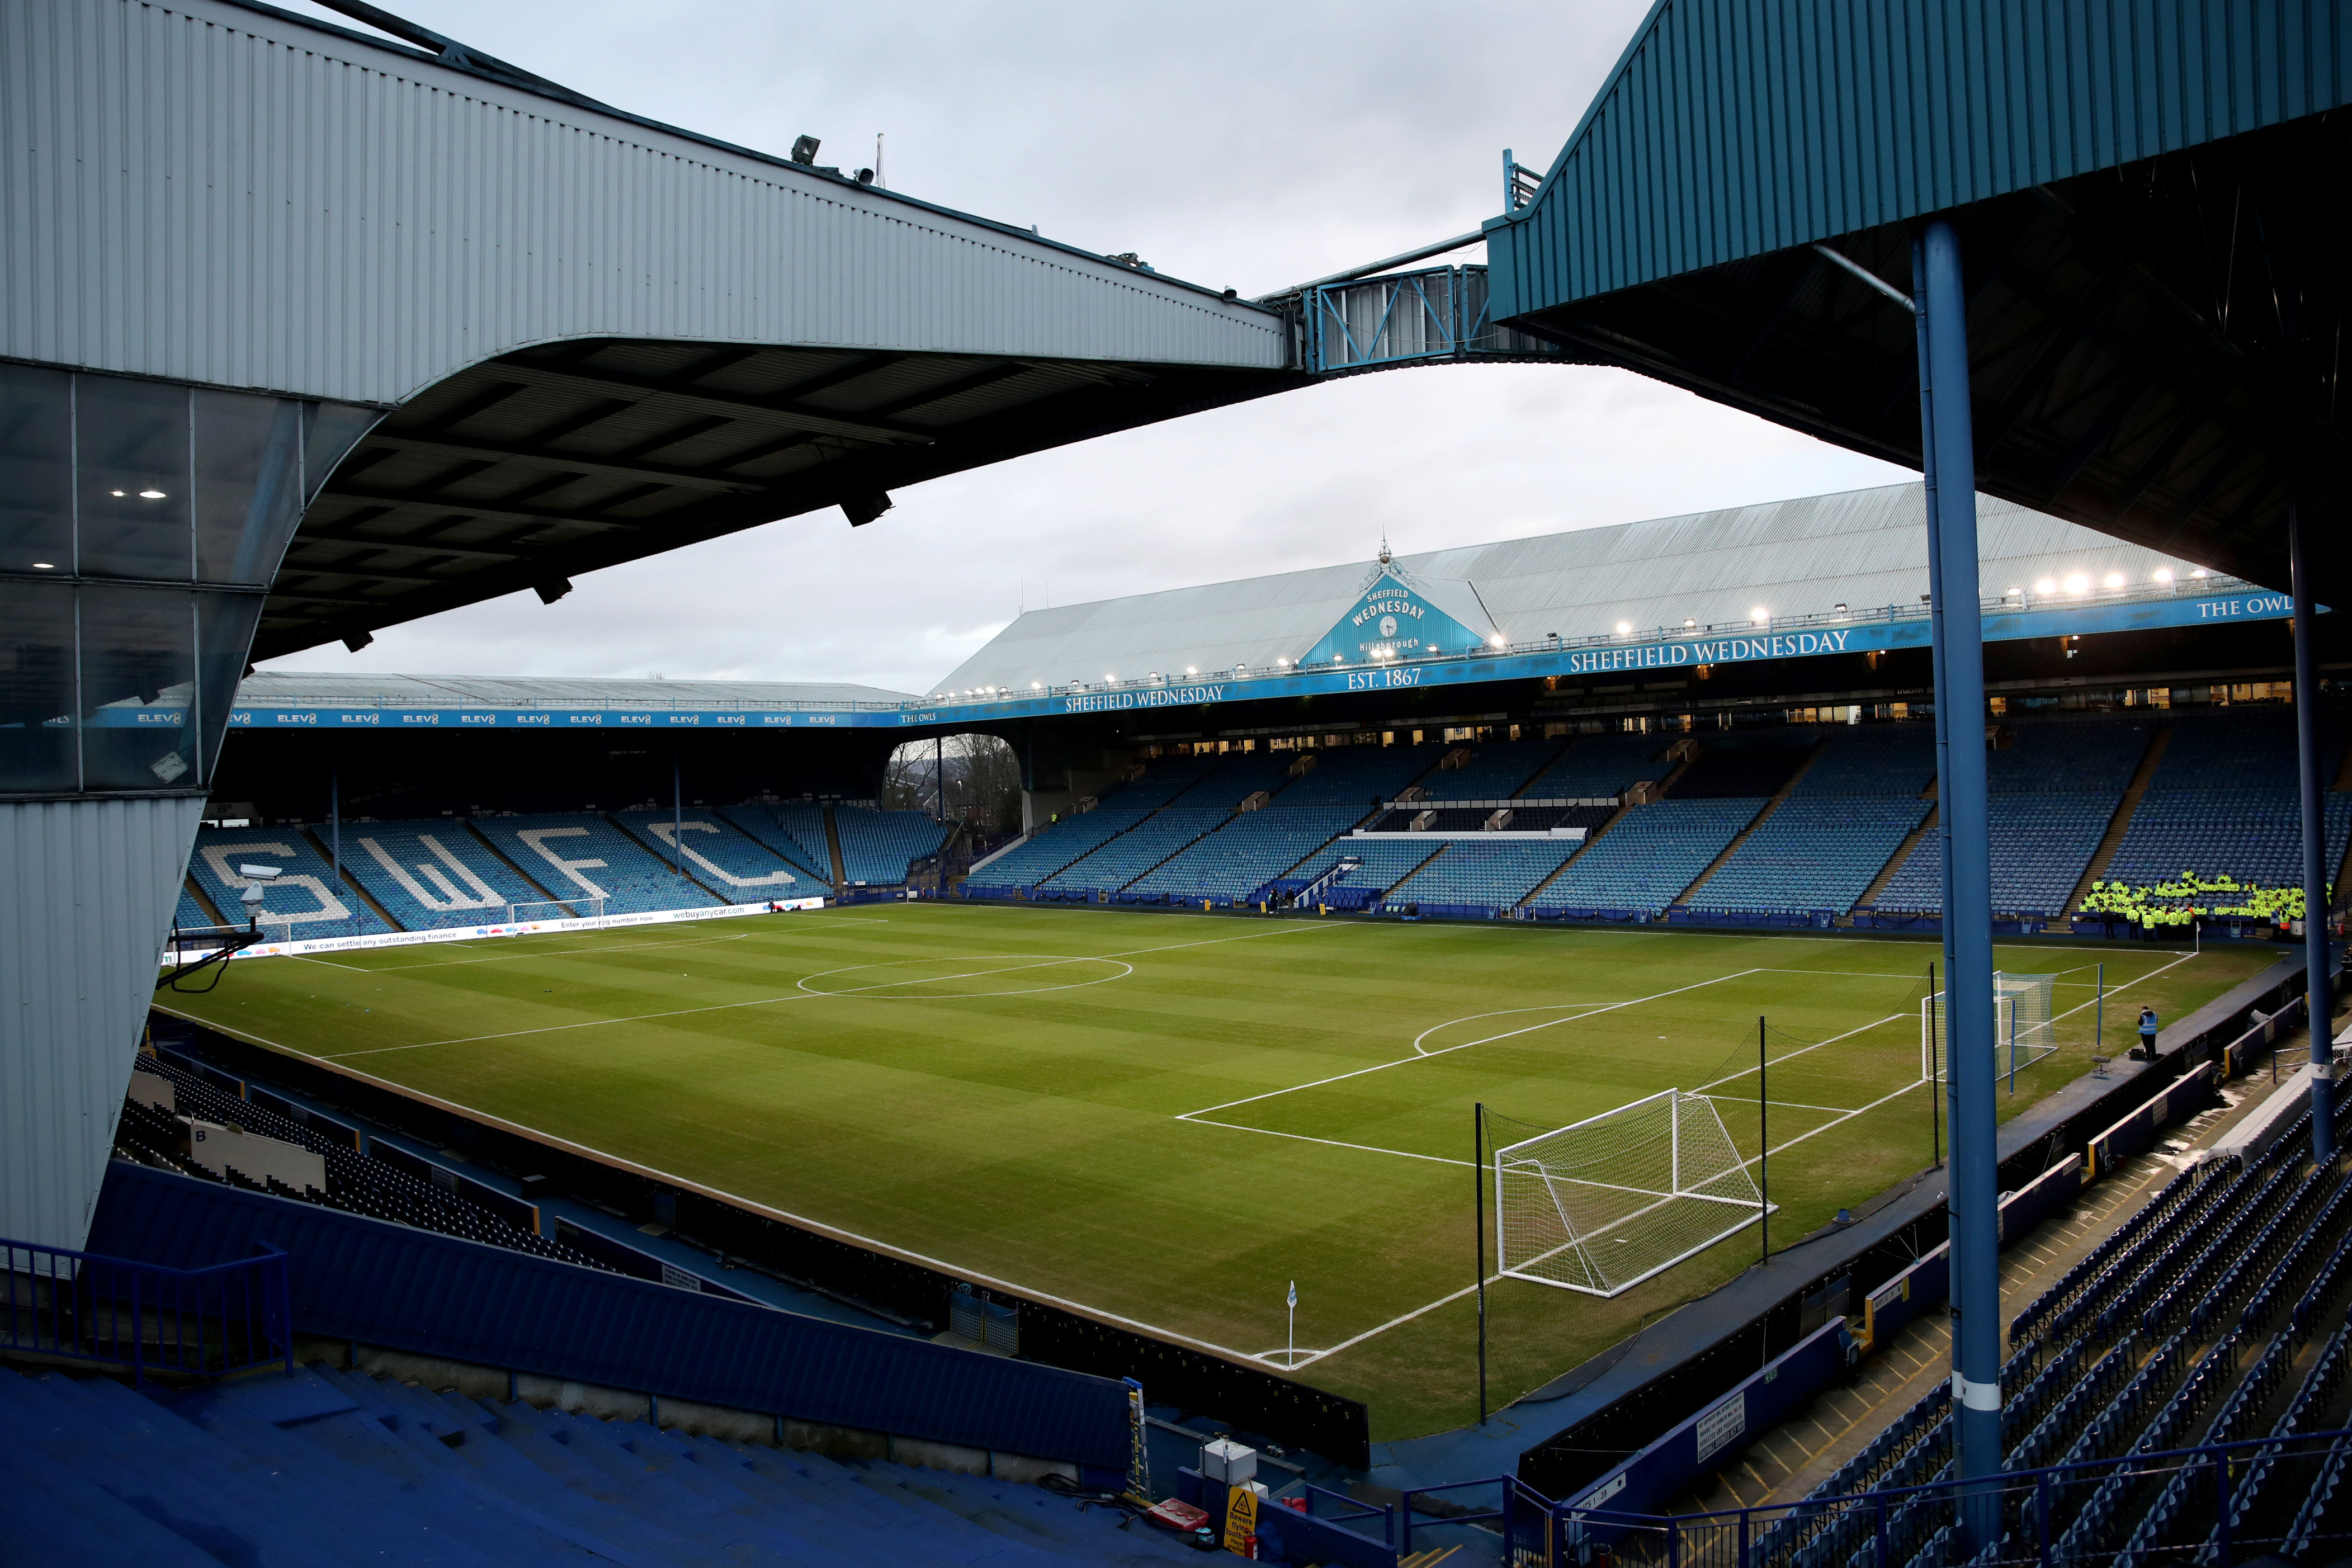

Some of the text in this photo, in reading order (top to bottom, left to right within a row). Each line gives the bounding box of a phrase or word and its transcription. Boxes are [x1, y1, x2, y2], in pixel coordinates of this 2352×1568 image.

[1367, 589, 1408, 603] SHEFFIELD
[2197, 595, 2293, 617] THE OWL
[1352, 601, 1425, 627] WEDNESDAY
[1359, 637, 1419, 651] Hillsborough
[1571, 630, 1850, 672] SHEFFIELD WEDNESDAY
[1348, 668, 1421, 690] EST. 1867
[1066, 685, 1225, 712] SHEFFIELD WEDNESDAY
[138, 712, 181, 724] ELEV8
[229, 712, 251, 724] EV8
[277, 712, 317, 724] ELEV8
[342, 713, 379, 724] ELEV8
[403, 714, 438, 724] ELEV8
[461, 714, 495, 725] ELEV8
[517, 714, 550, 725] ELEV8
[570, 714, 601, 724] ELEV8
[621, 715, 651, 724] ELEV8
[670, 715, 699, 725] ELEV8
[717, 715, 745, 725] ELEV8
[764, 715, 791, 725] ELEV8
[809, 715, 835, 725] ELEV8
[901, 712, 936, 723] THE OWLS
[673, 907, 744, 919] webuyanycar.com
[379, 934, 426, 944] outstanding
[196, 1130, 206, 1142] B
[1601, 1489, 1607, 1499] 39
[1230, 1512, 1252, 1525] Beware
[1226, 1528, 1245, 1540] footba
